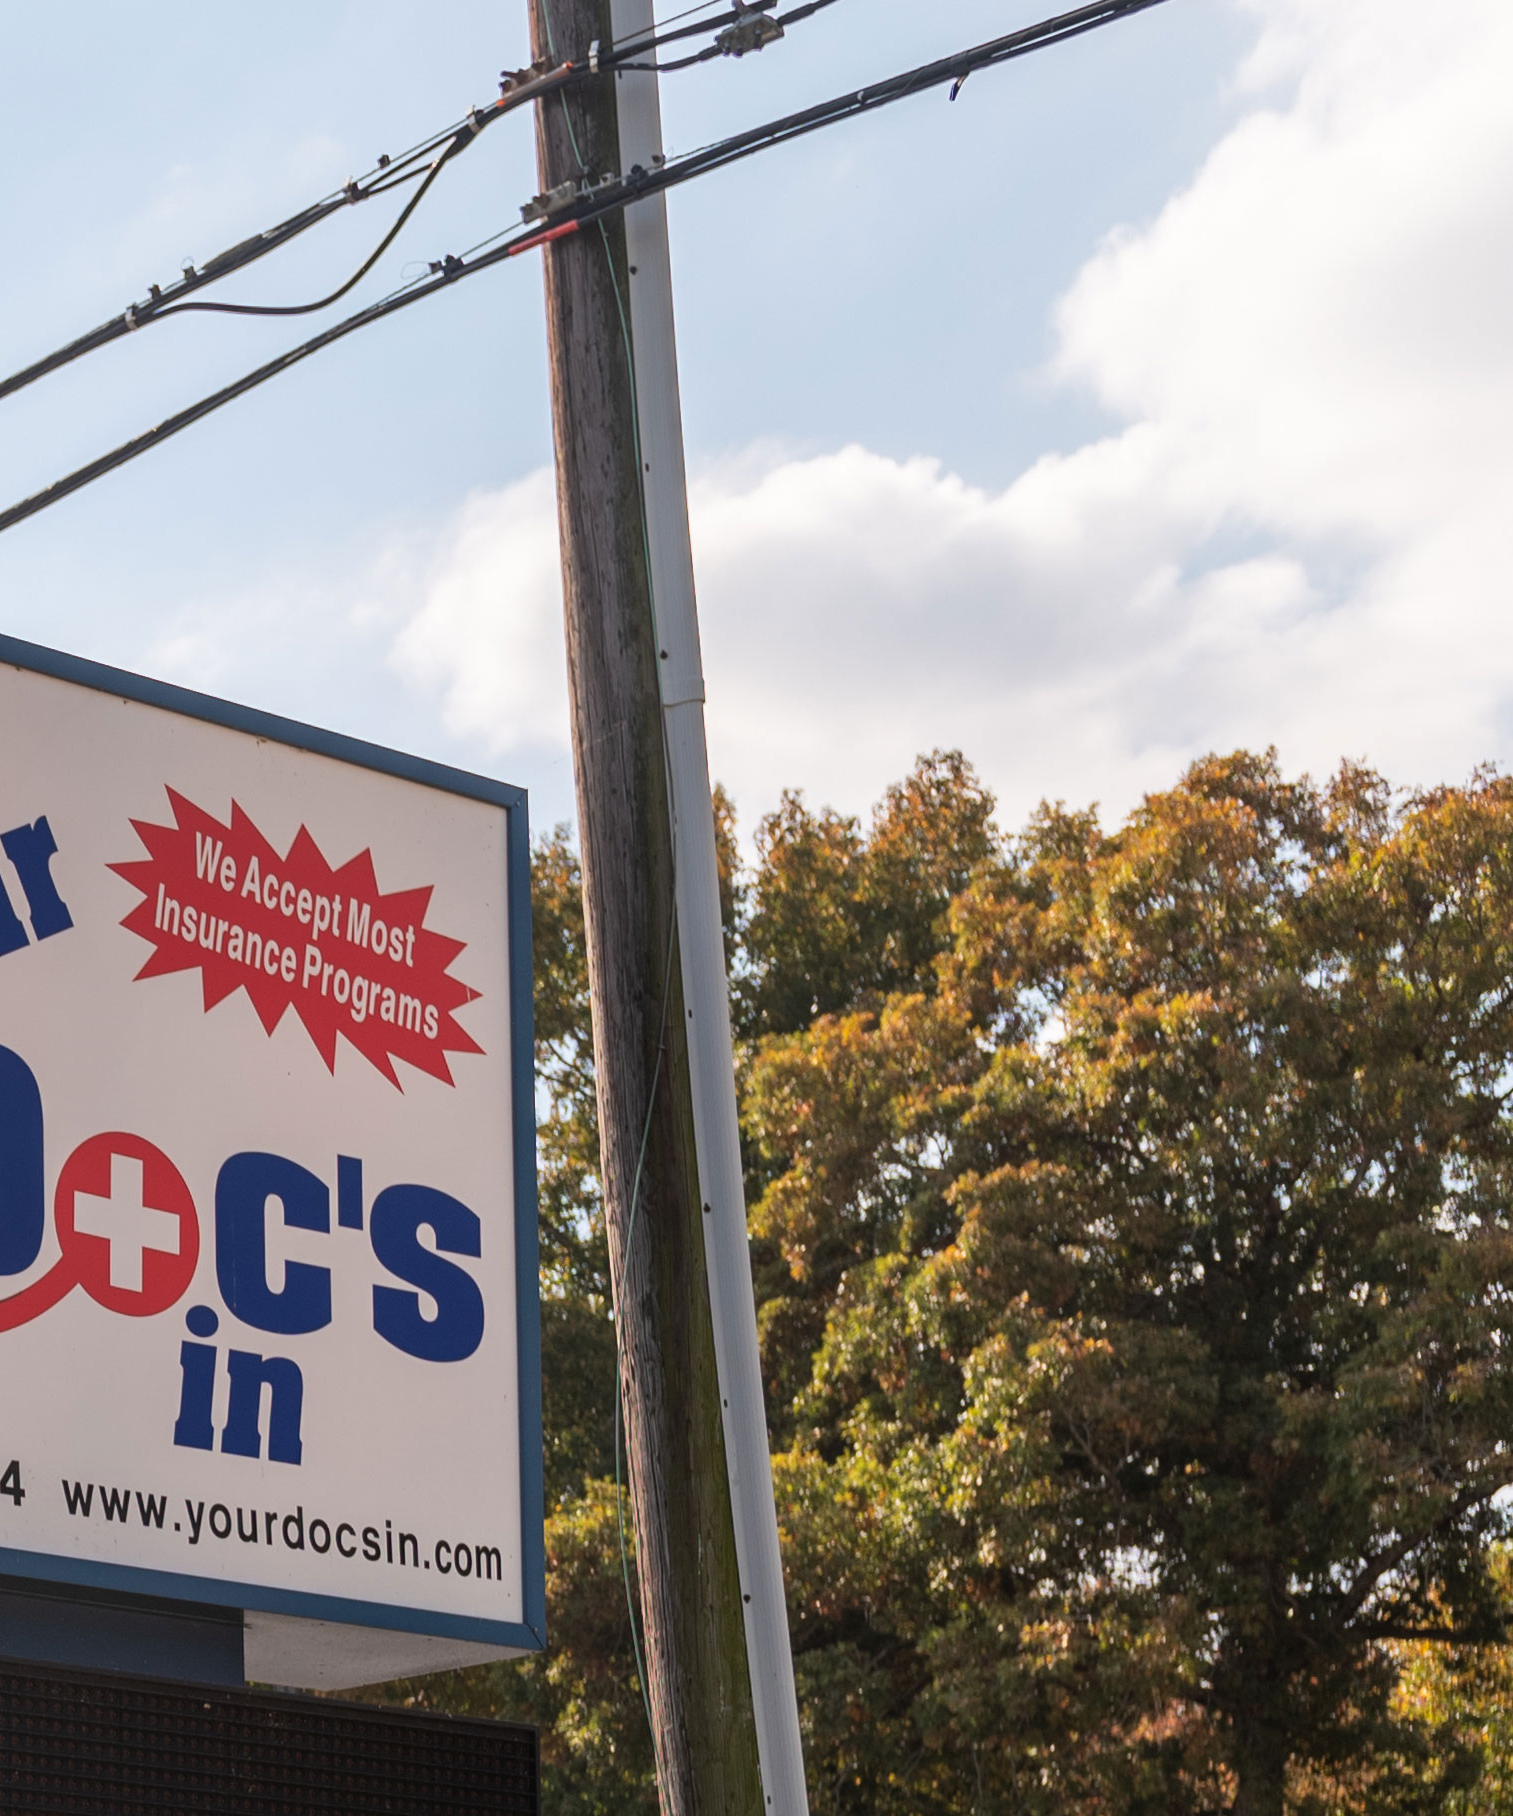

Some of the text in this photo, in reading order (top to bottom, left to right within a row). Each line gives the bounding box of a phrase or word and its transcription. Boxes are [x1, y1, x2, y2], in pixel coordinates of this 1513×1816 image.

[154, 881, 440, 1040] Insurance Programs
[195, 830, 417, 968] We Accept Most
[173, 1305, 304, 1466] in
[60, 1478, 504, 1582] www.yourdocsin.com
